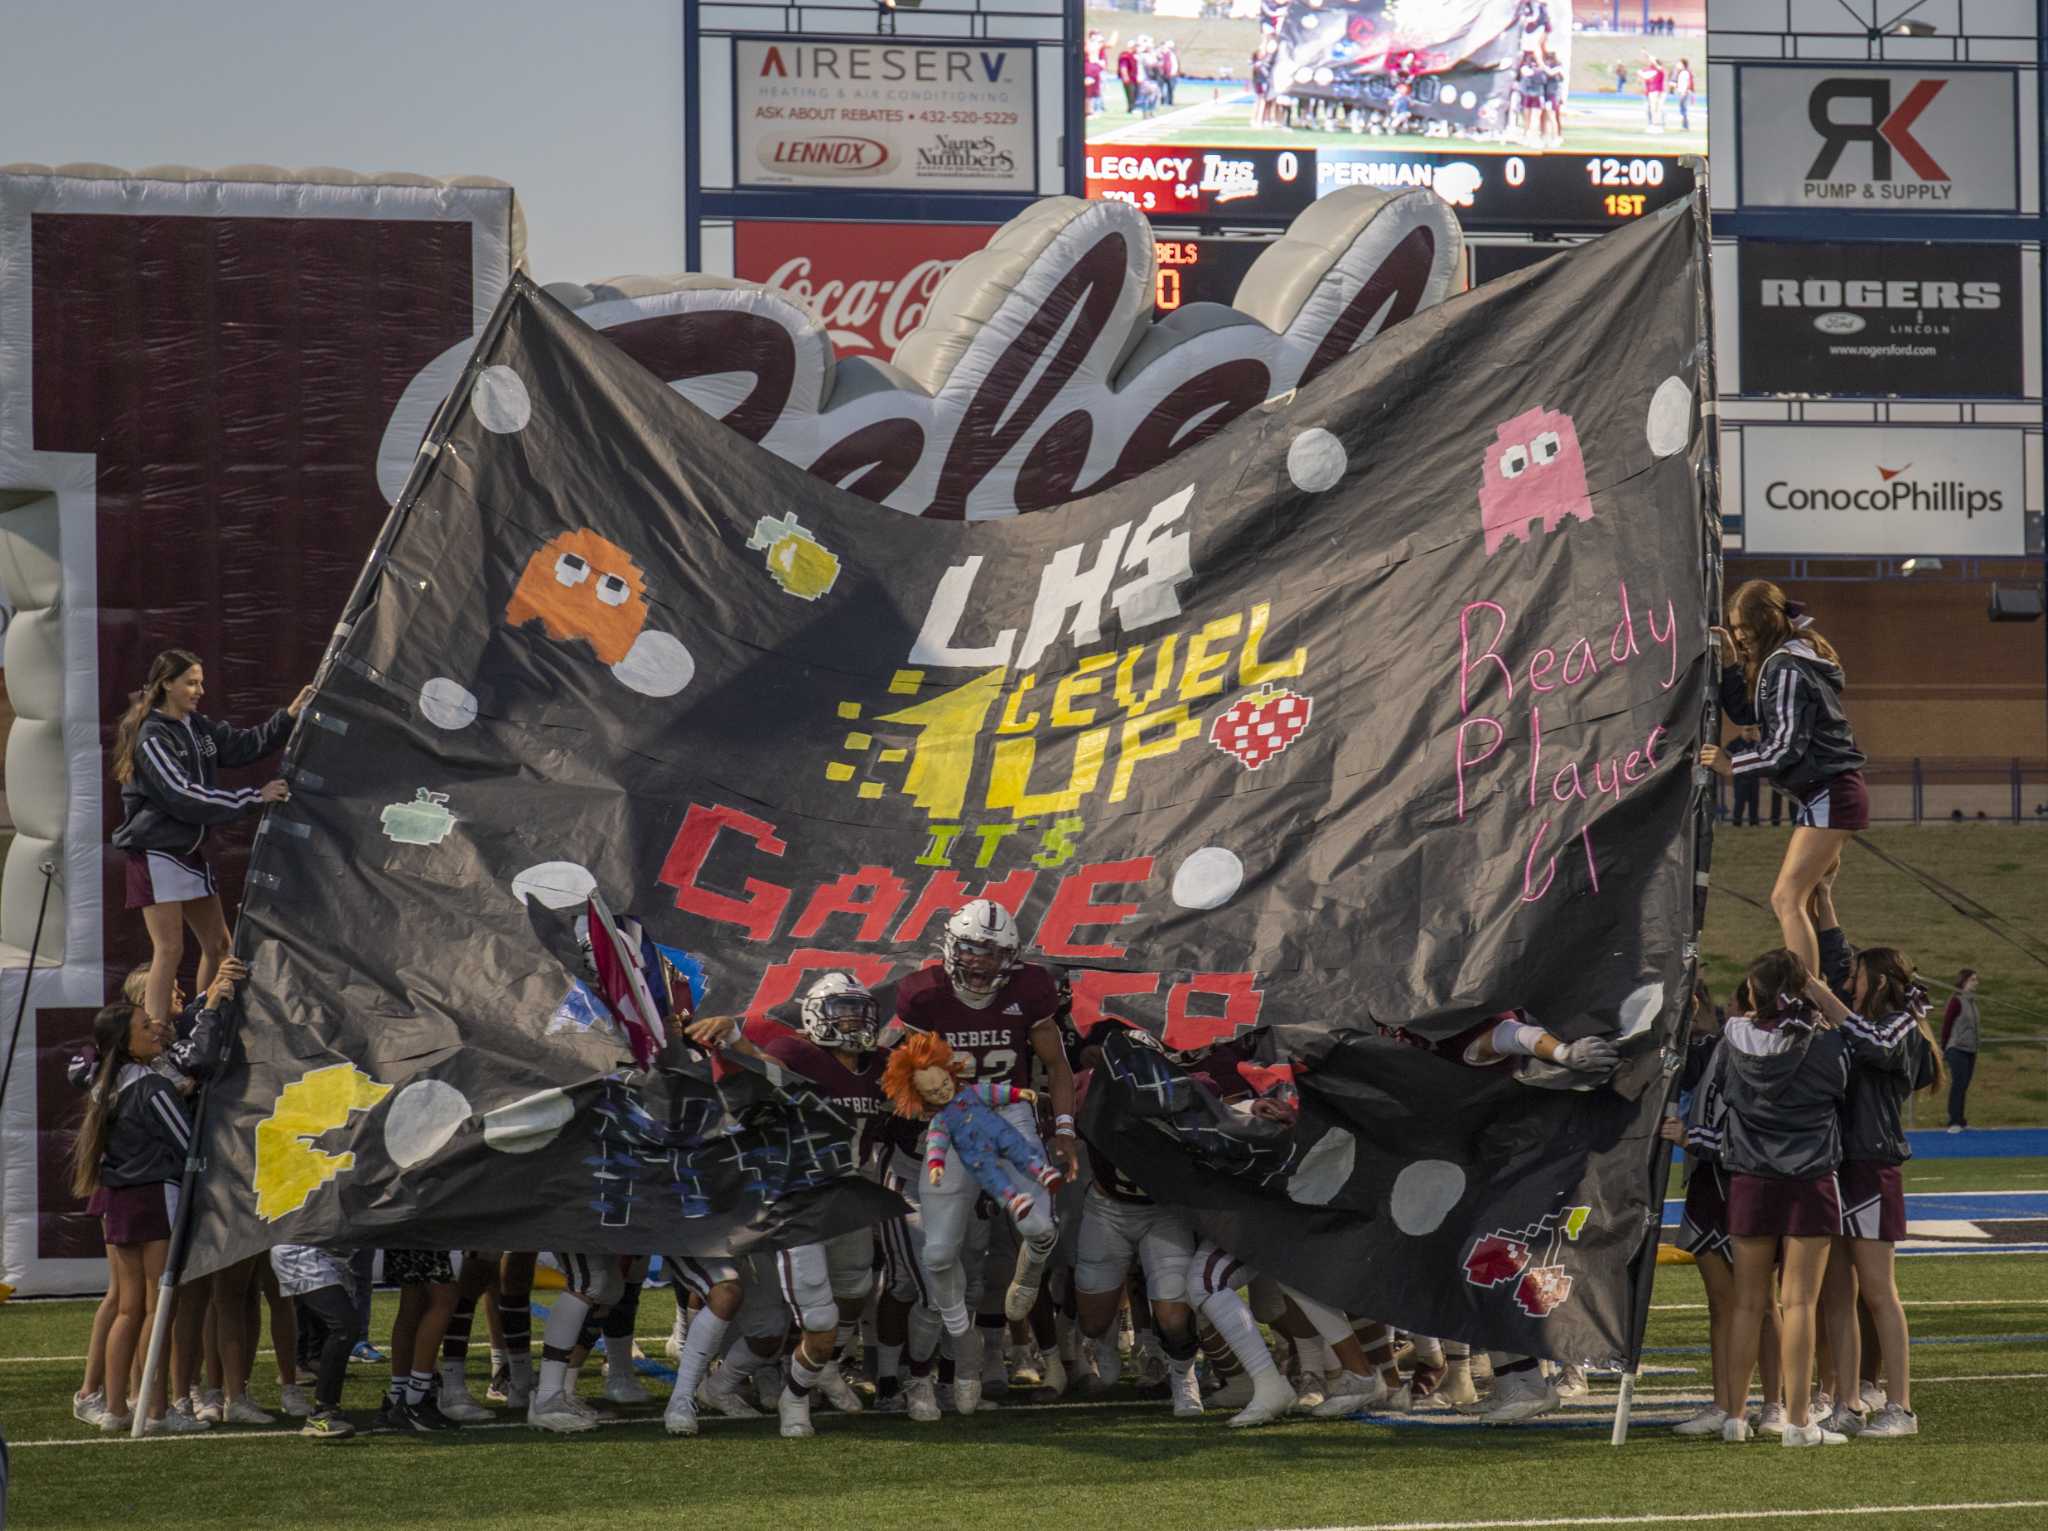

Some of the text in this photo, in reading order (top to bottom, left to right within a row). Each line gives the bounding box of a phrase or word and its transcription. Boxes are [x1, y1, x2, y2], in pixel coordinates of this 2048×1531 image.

[760, 46, 1006, 83] AIRESERV
[758, 87, 1009, 103] HEATING & AIR CONDITIONING
[756, 106, 1018, 125] ASK ABOUT REBATES 432-520-5229
[774, 141, 866, 165] LENNOX
[1278, 152, 1299, 182] 0
[1085, 156, 1192, 181] LEGACY
[1317, 162, 1434, 187] PERMIAN
[1505, 157, 1525, 186] 0
[1586, 158, 1664, 186] 12:00
[1142, 192, 1156, 208] 3
[1605, 195, 1646, 217] 1ST
[1804, 183, 1953, 201] PUMP & SUPPLY
[1155, 243, 1198, 264] BELS
[1157, 269, 1180, 310] 0
[1761, 278, 2002, 310] ROGERS
[1890, 325, 1951, 335] LINCOLN
[1829, 344, 1937, 358] www.rogersford.com
[1765, 480, 2004, 519] ConocoPhillips
[908, 483, 1196, 670] LHS
[1459, 578, 1677, 716] Ready
[995, 602, 1309, 735] LEVEL
[986, 702, 1203, 820] UP
[1455, 704, 1668, 823] Player
[915, 816, 1085, 869] IT'S
[658, 802, 1157, 958] GAME
[945, 1030, 1012, 1048] REBELS
